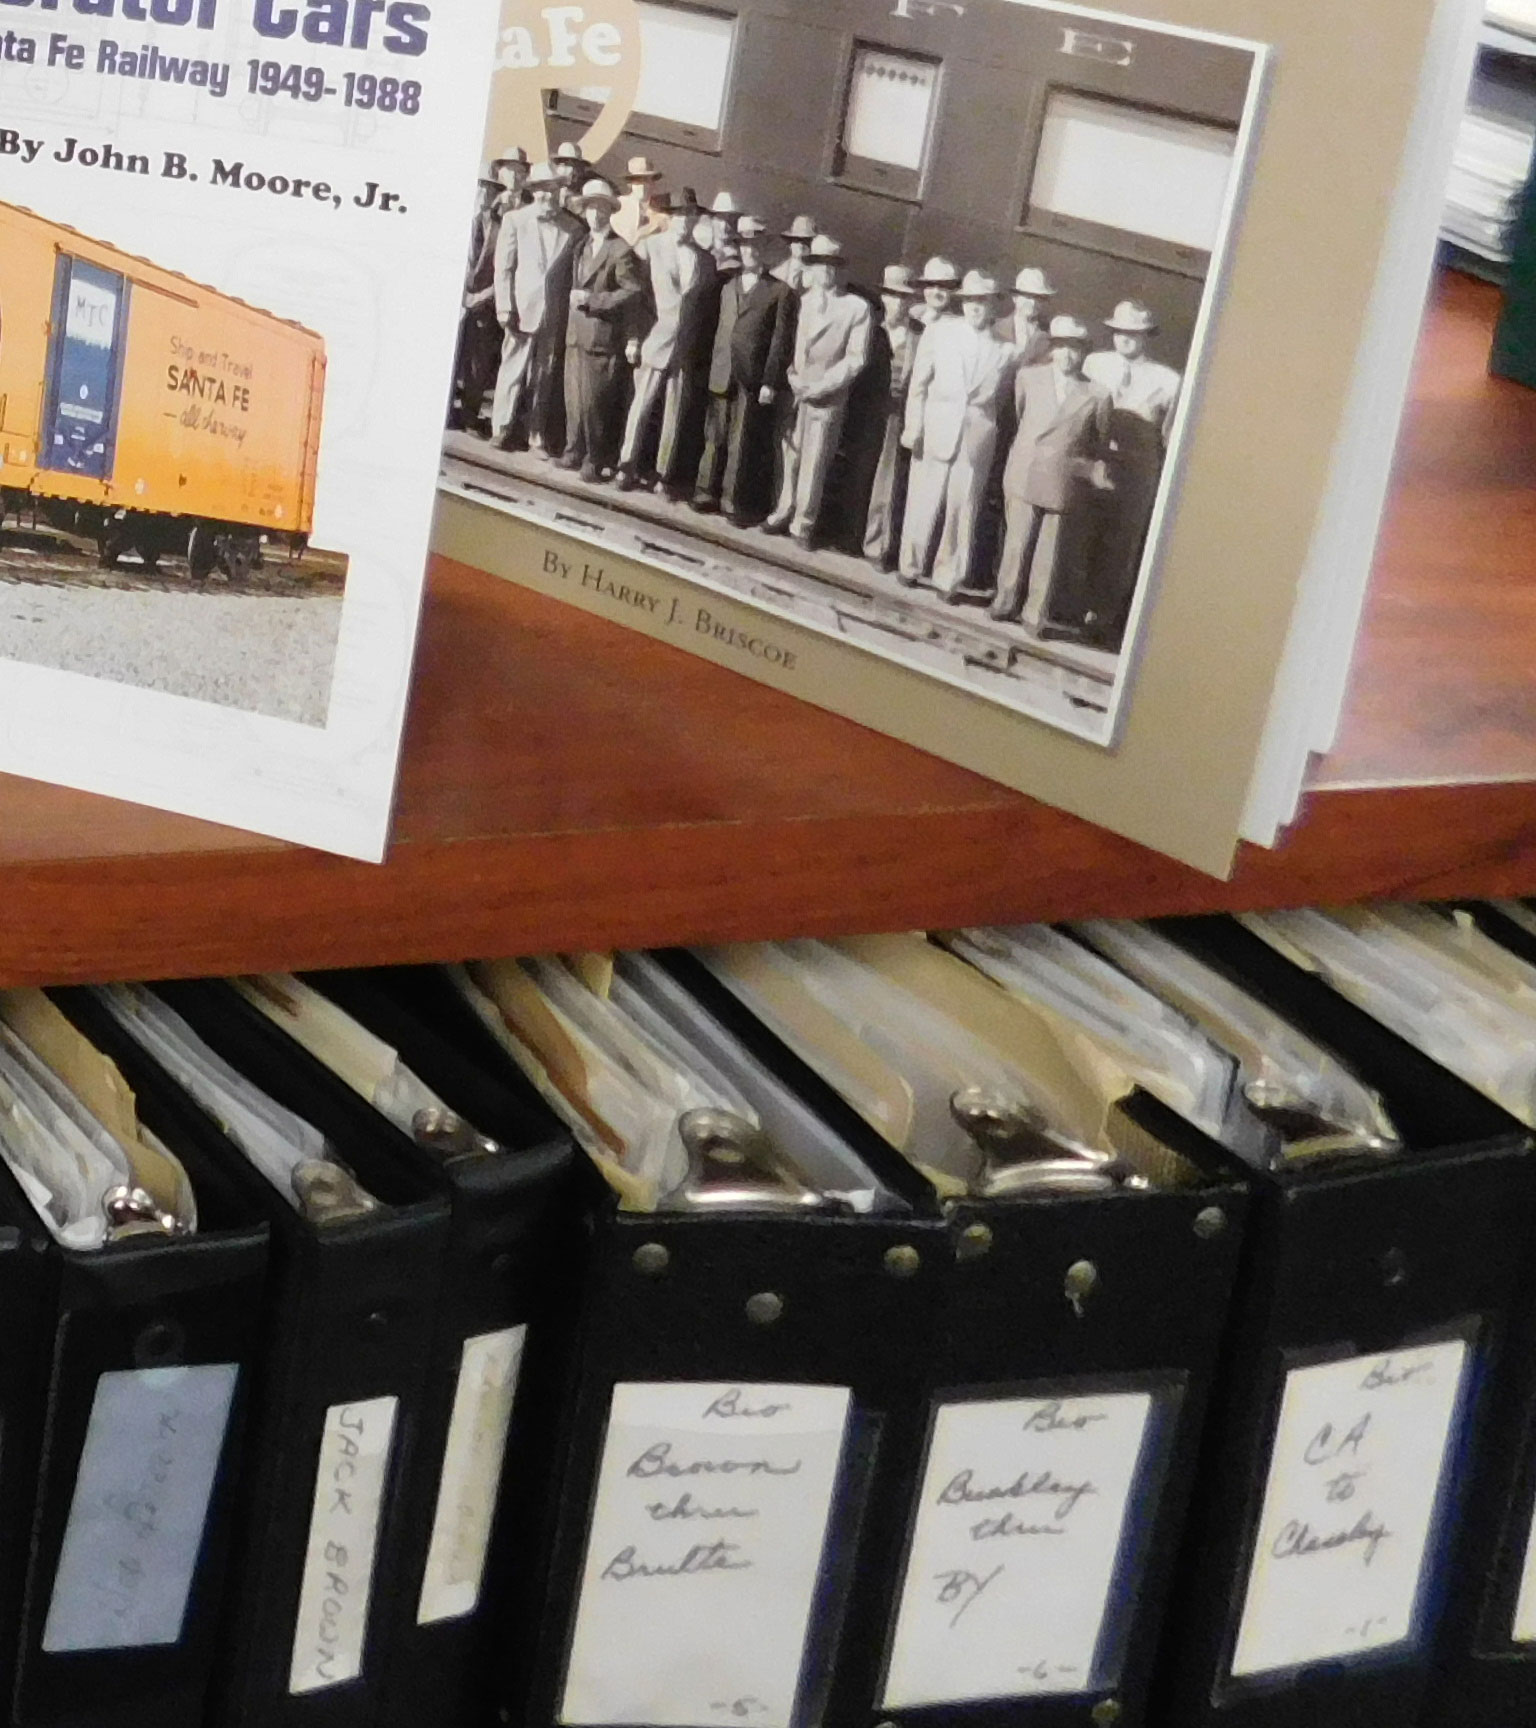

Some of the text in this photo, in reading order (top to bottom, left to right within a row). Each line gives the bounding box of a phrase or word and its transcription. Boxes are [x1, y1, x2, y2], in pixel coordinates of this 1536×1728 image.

[46, 33, 86, 70] Fe
[96, 38, 230, 98] Railway
[246, 58, 423, 117] 1949-1988
[541, 5, 623, 68] Fe
[53, 138, 150, 175] John
[161, 151, 198, 182] B.
[209, 158, 342, 210] Moore,
[353, 181, 408, 214] Jr.
[166, 364, 251, 413] SANTA FE
[581, 564, 661, 614] HARRY
[695, 608, 800, 671] BRISCOE
[314, 1406, 364, 1681] JACK BROWN
